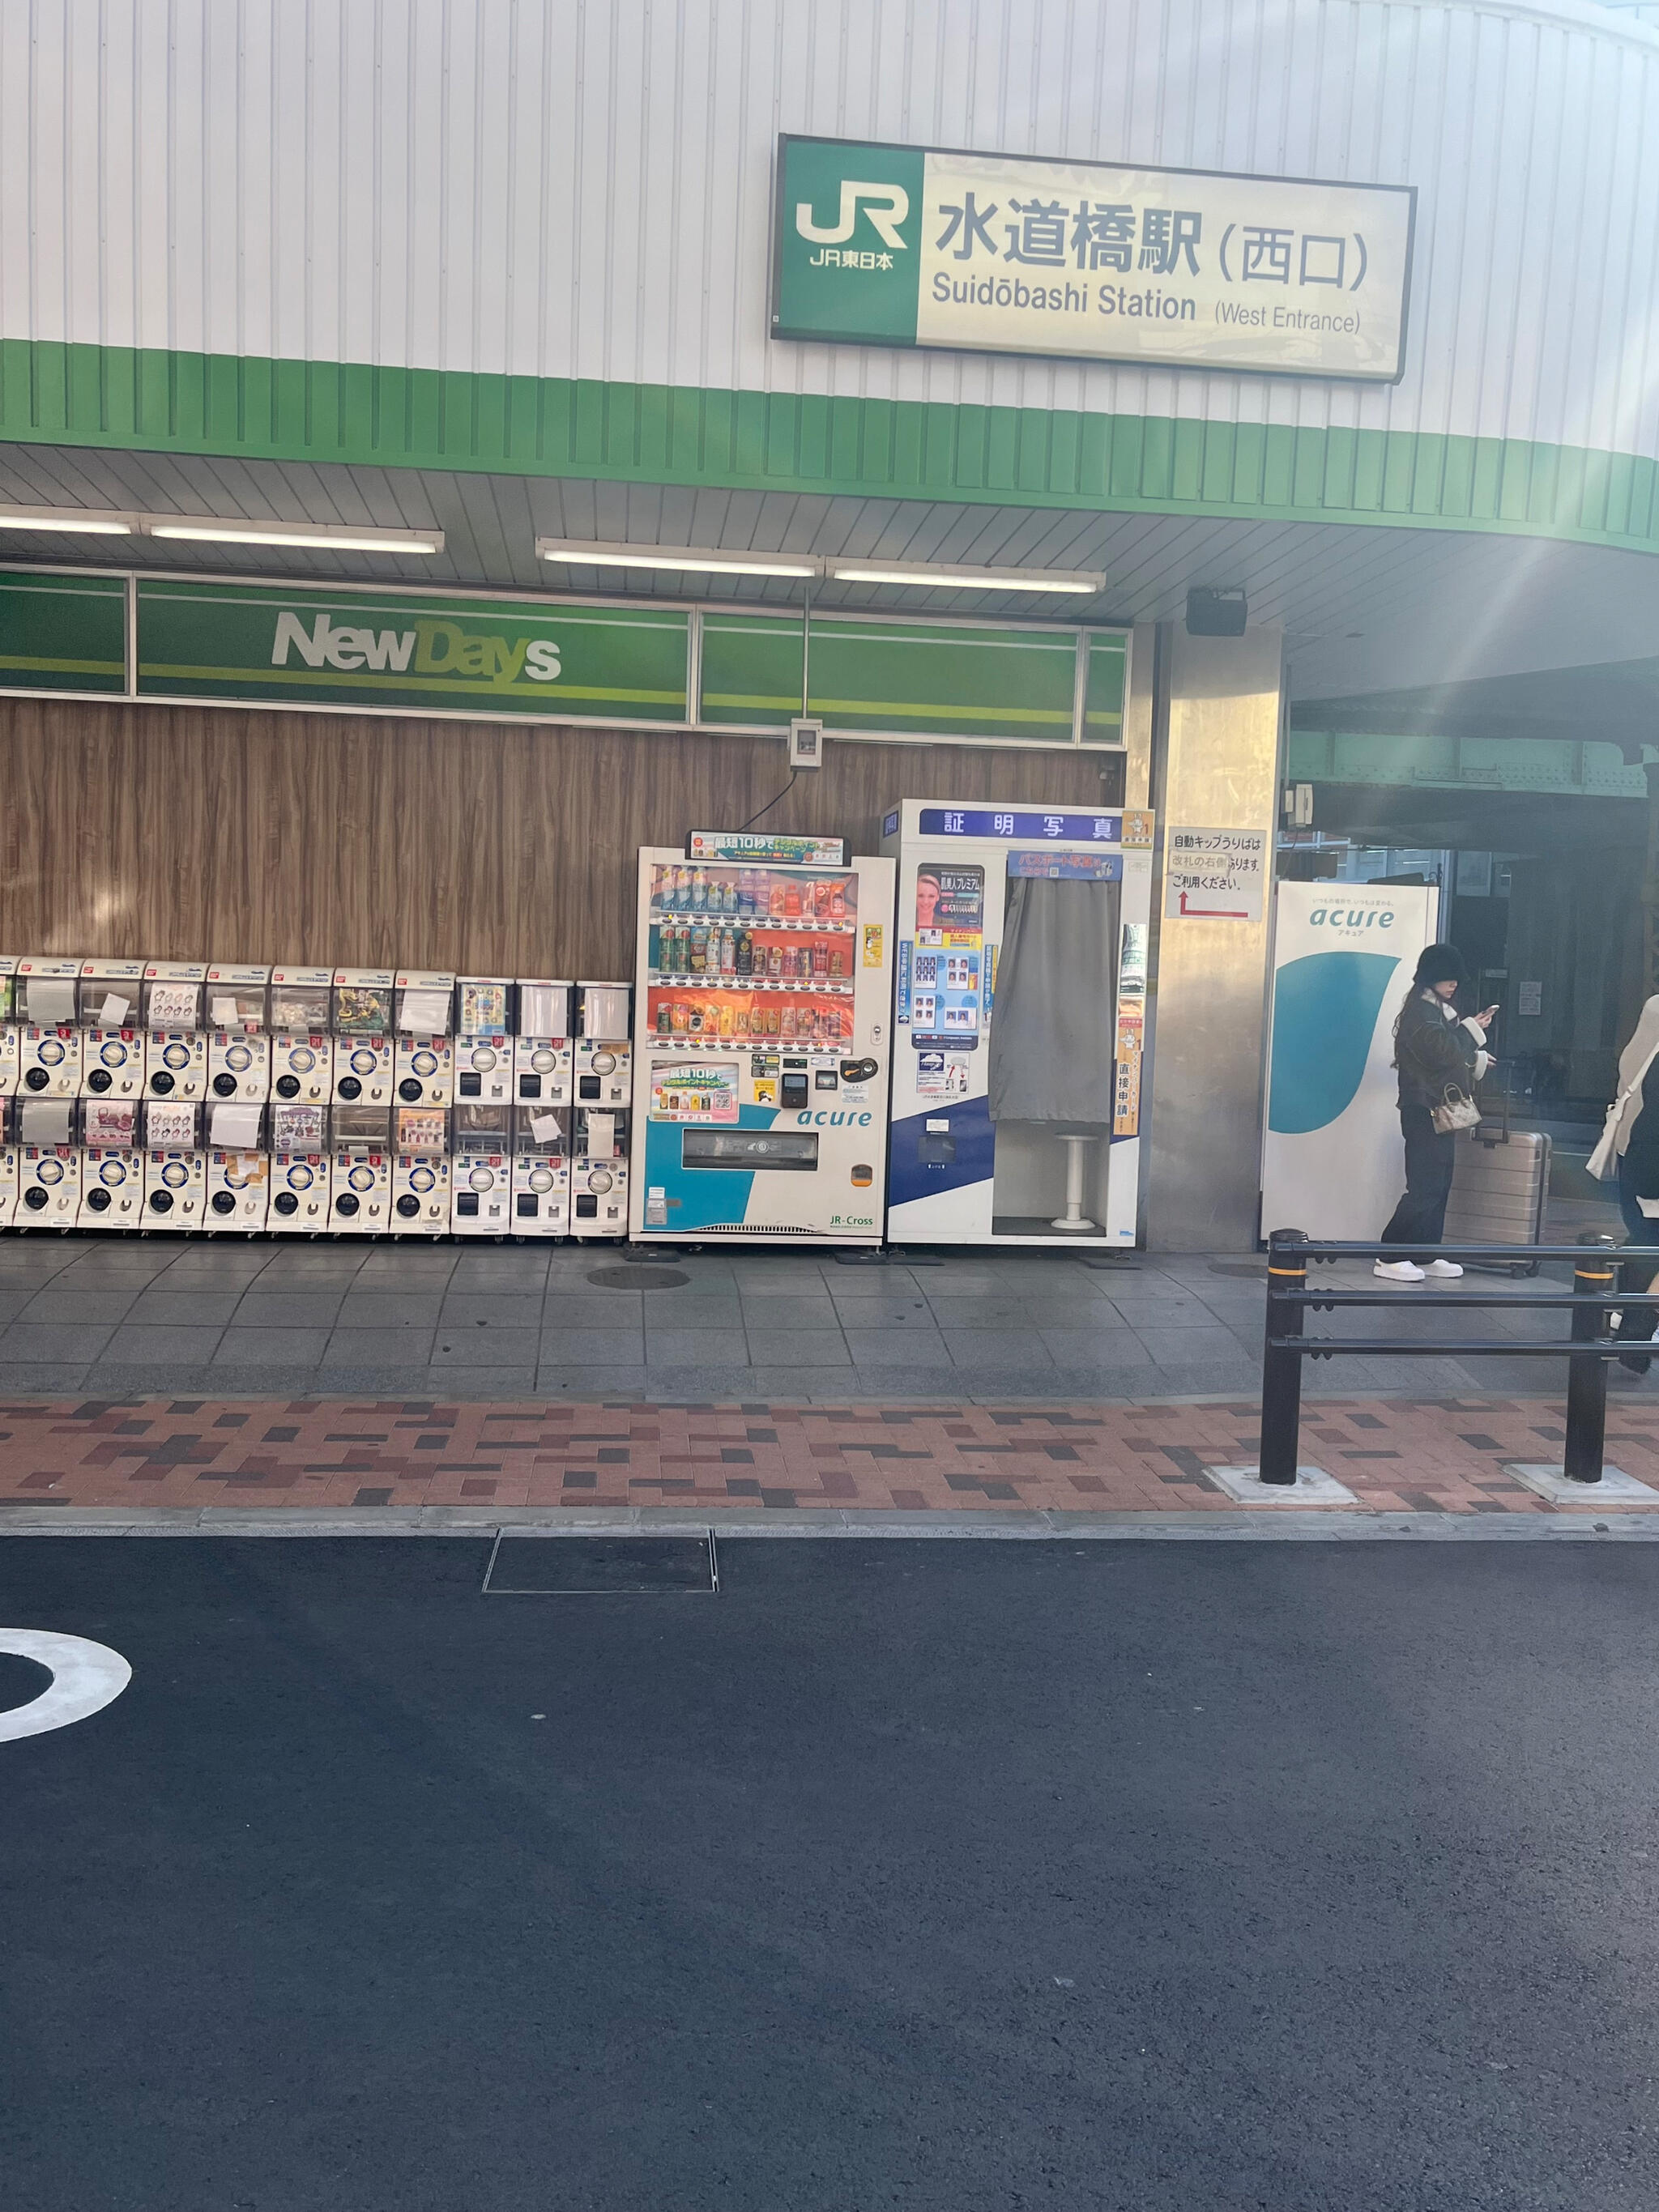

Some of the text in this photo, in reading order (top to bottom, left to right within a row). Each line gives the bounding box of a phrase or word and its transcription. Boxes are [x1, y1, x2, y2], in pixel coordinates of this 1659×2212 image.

[795, 180, 909, 249] JR
[935, 191, 1368, 292] 水道橋駅 （西口）
[809, 248, 894, 271] JR東日本
[932, 271, 1361, 335] Suidōbashi Station (West Entrance)
[272, 612, 561, 684] NewDays
[944, 812, 1113, 839] 証明写真
[714, 836, 774, 849] 最短10秒で
[1175, 834, 1261, 850] 自動キップうりばは
[1173, 874, 1241, 890] ご利用ください。
[1309, 909, 1395, 928] acure
[1116, 1063, 1130, 1116] 直接申請
[797, 1109, 873, 1127] acure
[830, 1216, 873, 1225] JR-Cross
